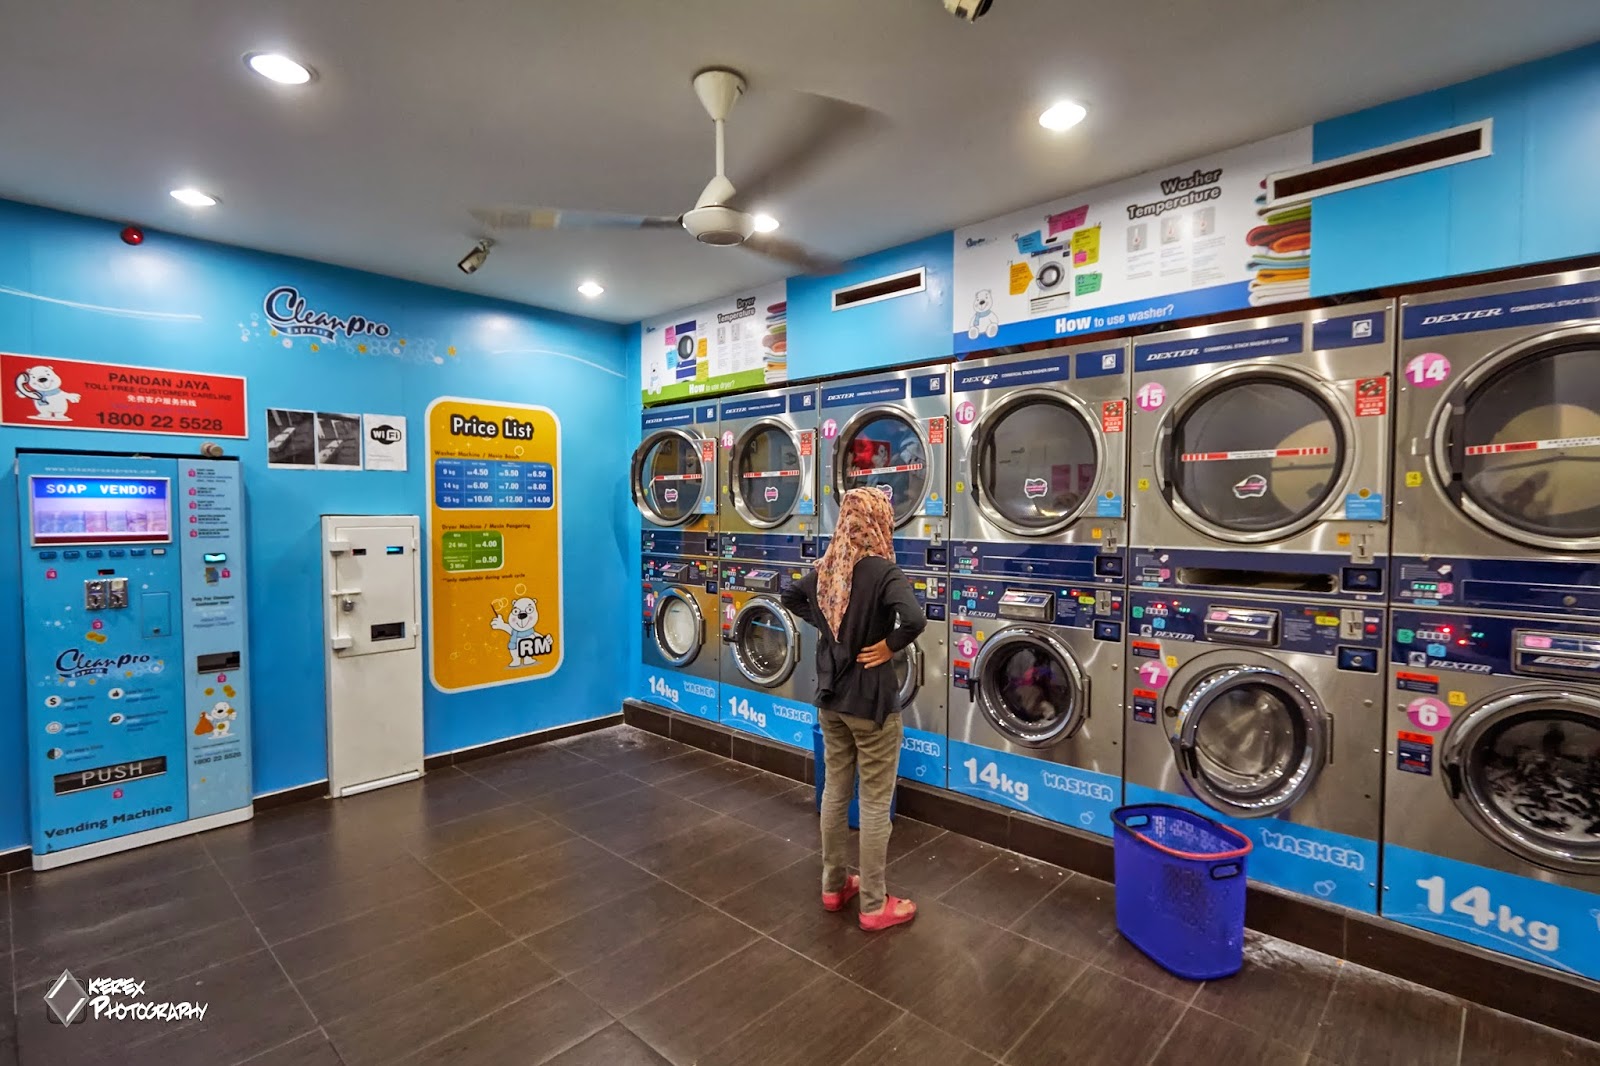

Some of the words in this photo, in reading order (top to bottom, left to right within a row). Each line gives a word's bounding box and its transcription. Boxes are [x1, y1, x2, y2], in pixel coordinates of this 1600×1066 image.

[1160, 168, 1222, 195] Washer
[1127, 187, 1222, 220] Temperature
[264, 286, 390, 337] Cleanpro
[736, 297, 756, 309] Dryer
[717, 307, 756, 323] Temperature
[1056, 315, 1092, 334] How
[1094, 316, 1104, 328] to
[1107, 314, 1126, 326] use
[1128, 304, 1175, 323] washer?
[1421, 308, 1503, 325] DEXTER
[1146, 347, 1200, 361] DEXTER
[962, 373, 998, 385] DEXTER
[1409, 359, 1447, 383] 14
[108, 372, 172, 387] PANDAN
[176, 379, 210, 390] JAYA
[689, 383, 705, 394] How
[84, 382, 108, 391] TOLL
[112, 385, 136, 393] FREE
[138, 387, 189, 397] CUSTOMER
[191, 391, 232, 401] CARELINE
[827, 392, 855, 401] DEXTER
[1139, 387, 1163, 407] 15
[96, 411, 144, 427] 1800
[151, 415, 174, 429] 22
[180, 417, 223, 431] 5528
[957, 406, 975, 421] 16
[452, 416, 497, 437] Price
[504, 420, 532, 438] List
[823, 421, 837, 436] 17
[722, 434, 734, 447] 18
[46, 484, 87, 494] SOAP
[100, 484, 157, 495] VENDOR
[967, 610, 997, 618] DEXTER
[1154, 630, 1195, 641] DEXTER
[519, 637, 552, 657] RM
[963, 638, 973, 655] 8
[56, 648, 150, 671] Cleanpro
[1429, 659, 1493, 673] DEXTER
[1148, 666, 1161, 684] 7
[648, 675, 679, 703] 14kg
[684, 680, 716, 699] WASHER
[729, 696, 766, 727] 14kg
[773, 703, 813, 724] WASHER
[1418, 704, 1439, 727] 6
[82, 762, 142, 785] PUSH
[964, 757, 1029, 802] 14kg
[1042, 770, 1114, 802] WASHER
[44, 817, 108, 838] Vending
[113, 804, 173, 824] Machine
[1259, 827, 1365, 871] WASHER
[1416, 875, 1559, 951] 14kg
